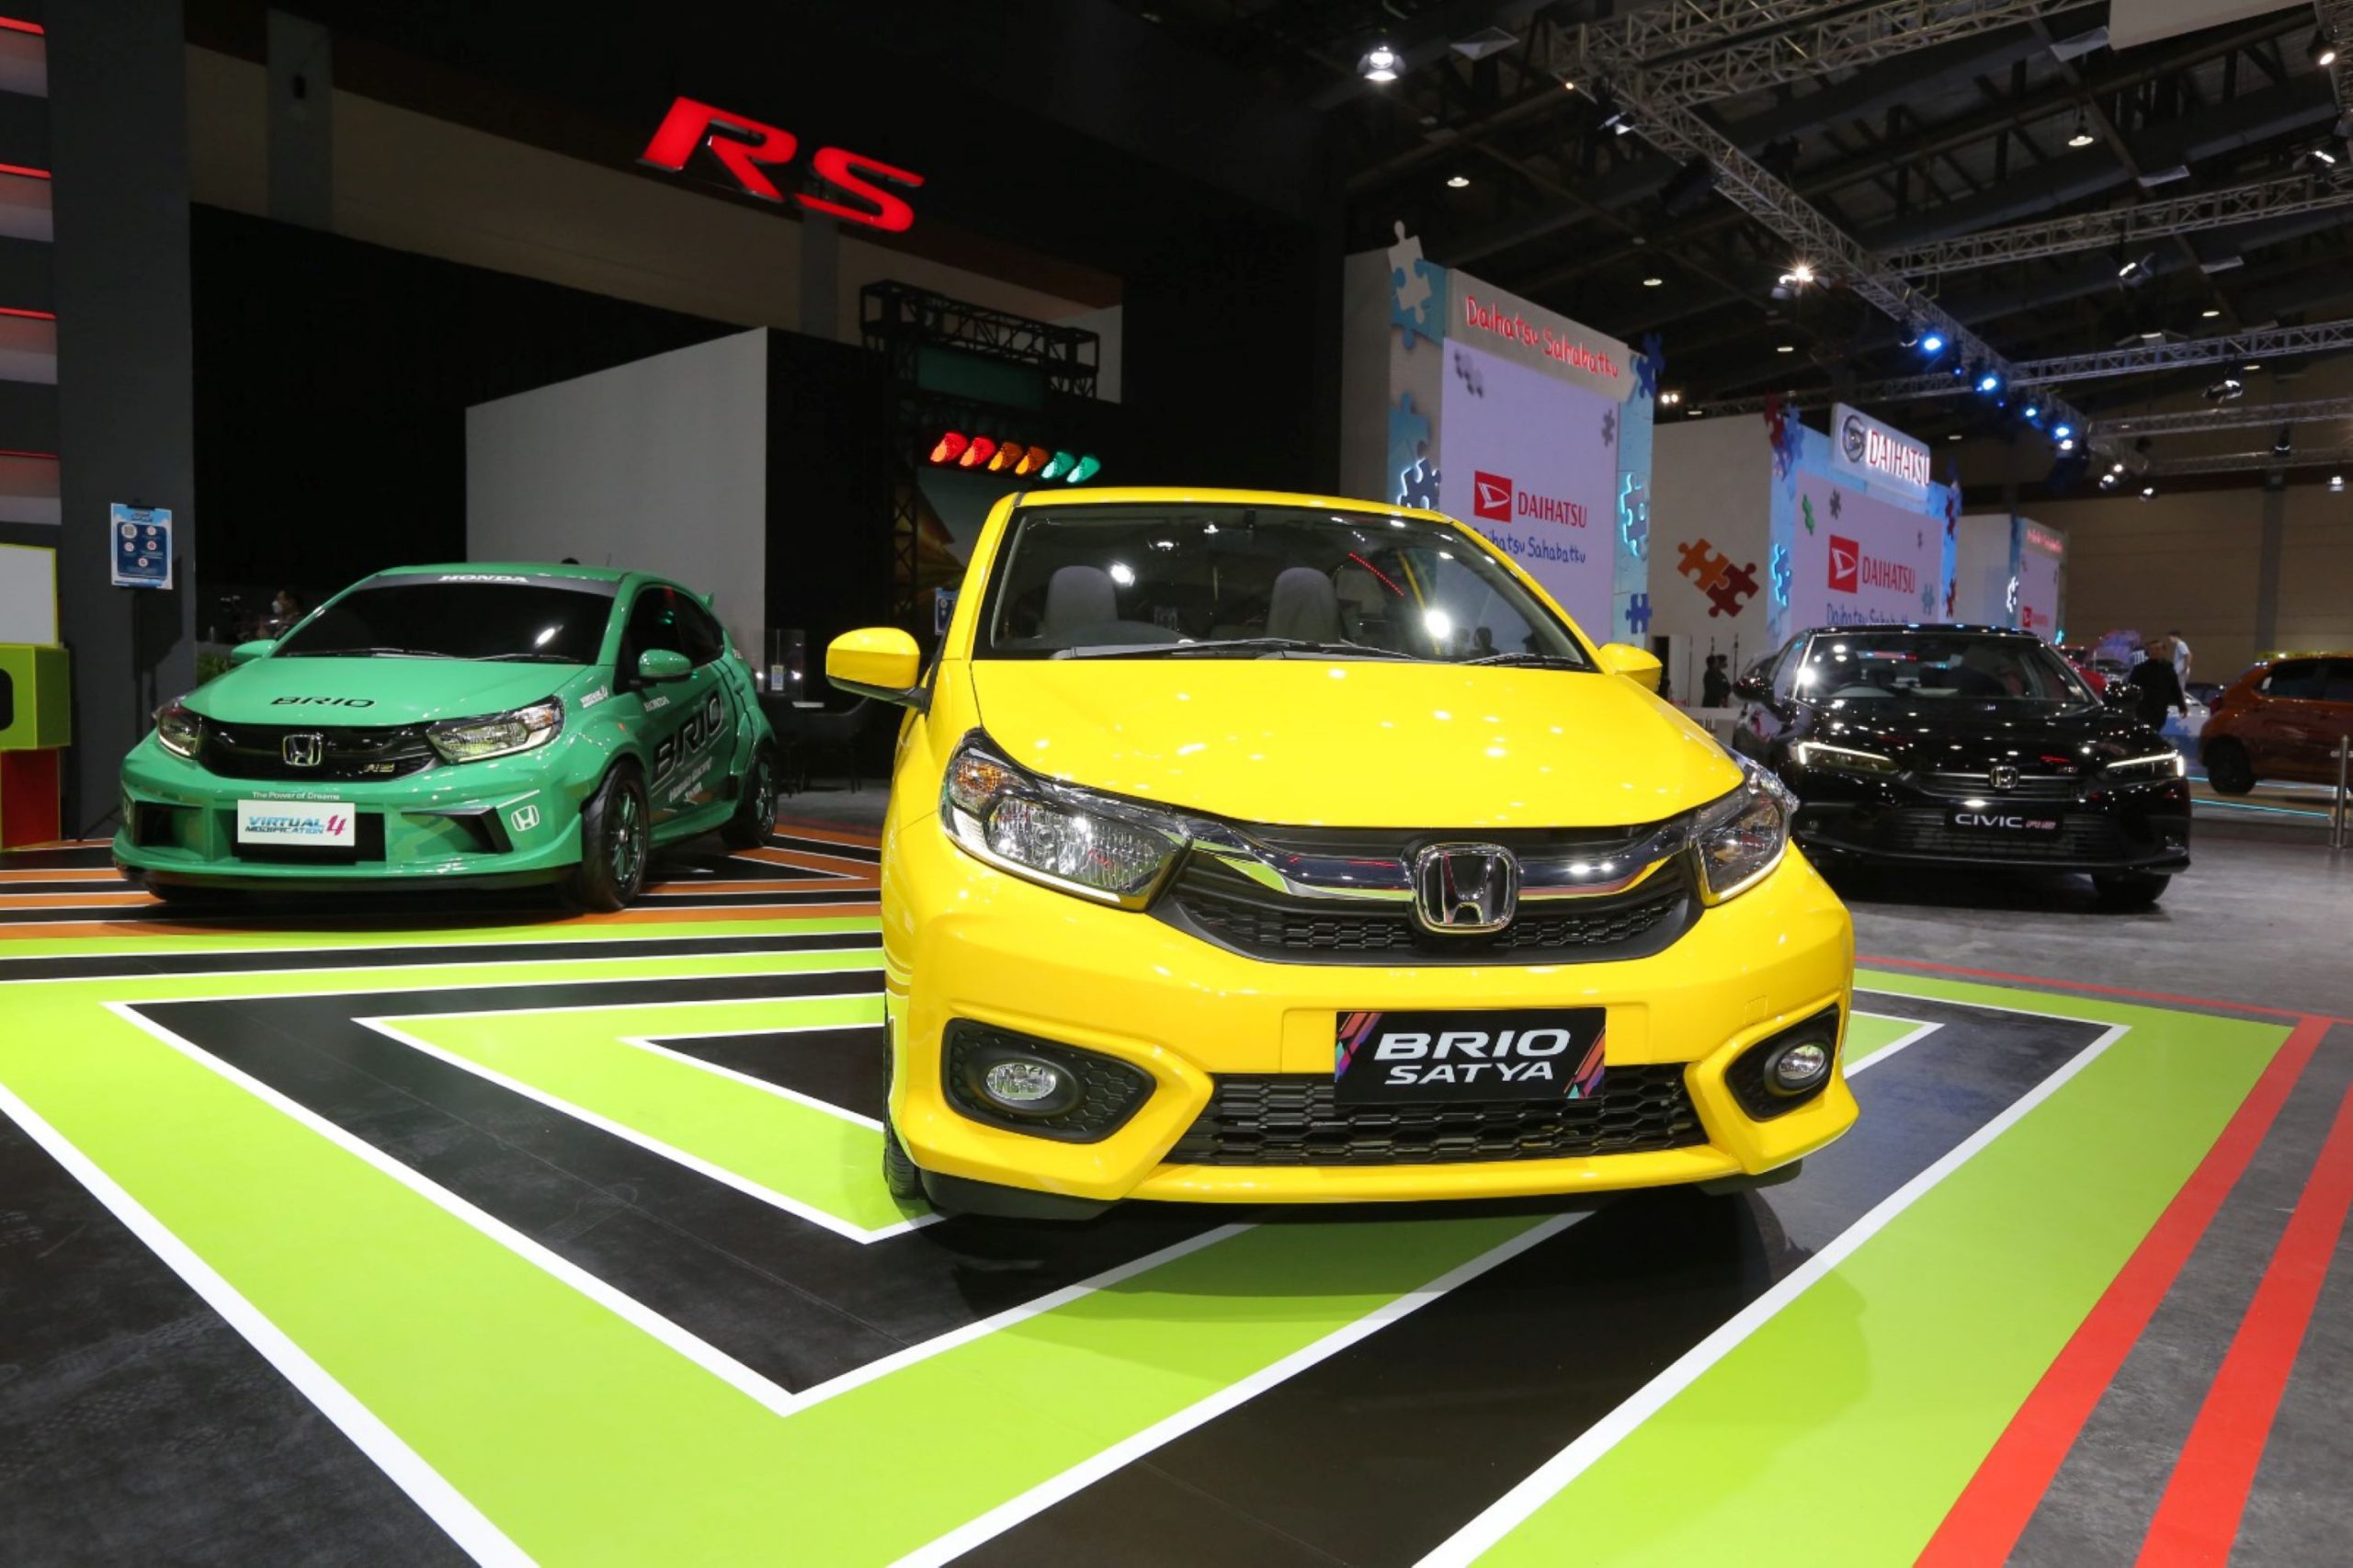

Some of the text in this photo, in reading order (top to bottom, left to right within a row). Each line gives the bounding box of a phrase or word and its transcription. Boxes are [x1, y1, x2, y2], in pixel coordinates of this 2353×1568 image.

[639, 96, 925, 233] RS
[1466, 294, 1540, 347] Daihatsu
[1866, 428, 1930, 487] DAIHATSU
[1518, 492, 1587, 528] DAIHATSU
[1473, 528, 1526, 554] hatsu
[438, 574, 529, 583] HONDA
[1862, 556, 1915, 594] DAIHATSU
[270, 697, 376, 708] BRIO
[268, 791, 295, 800] Power
[296, 791, 305, 800] of
[307, 792, 340, 801] Dreams
[248, 816, 324, 827] VIRTUAL
[326, 813, 347, 835] 4
[1955, 813, 2023, 828] CIVIC
[1373, 1028, 1572, 1060] BRIO
[1384, 1061, 1553, 1085] SATYA
